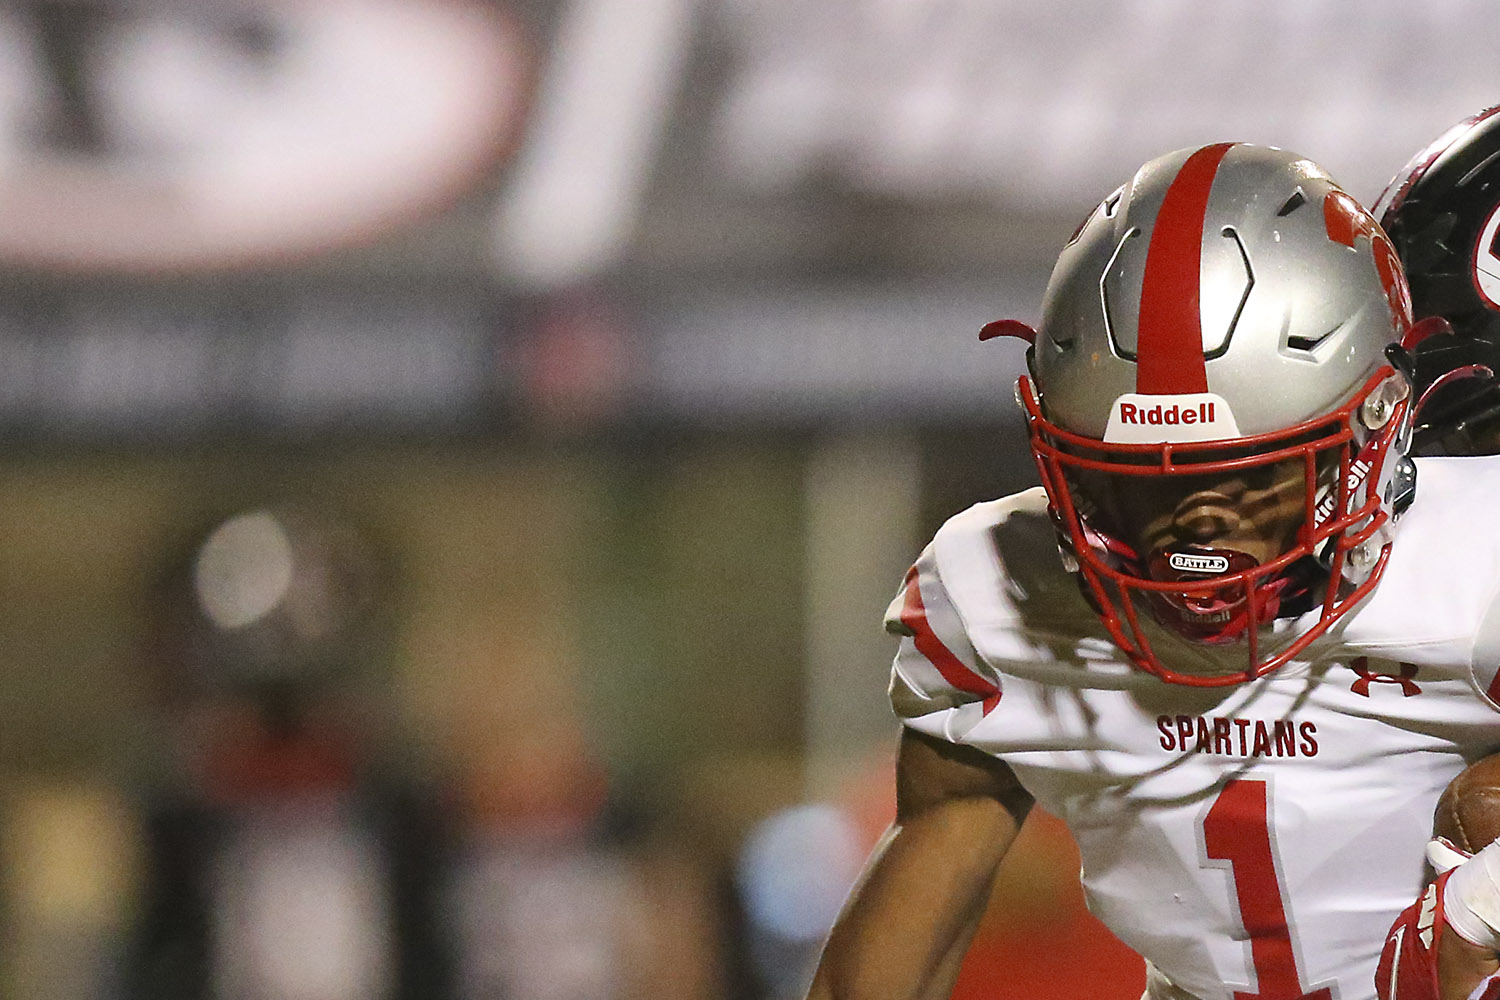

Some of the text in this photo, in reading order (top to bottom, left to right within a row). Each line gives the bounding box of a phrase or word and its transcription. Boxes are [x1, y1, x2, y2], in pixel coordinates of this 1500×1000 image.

[1120, 402, 1215, 425] Riddell
[1174, 556, 1224, 569] BATTLE
[1156, 715, 1319, 758] SPARTANS
